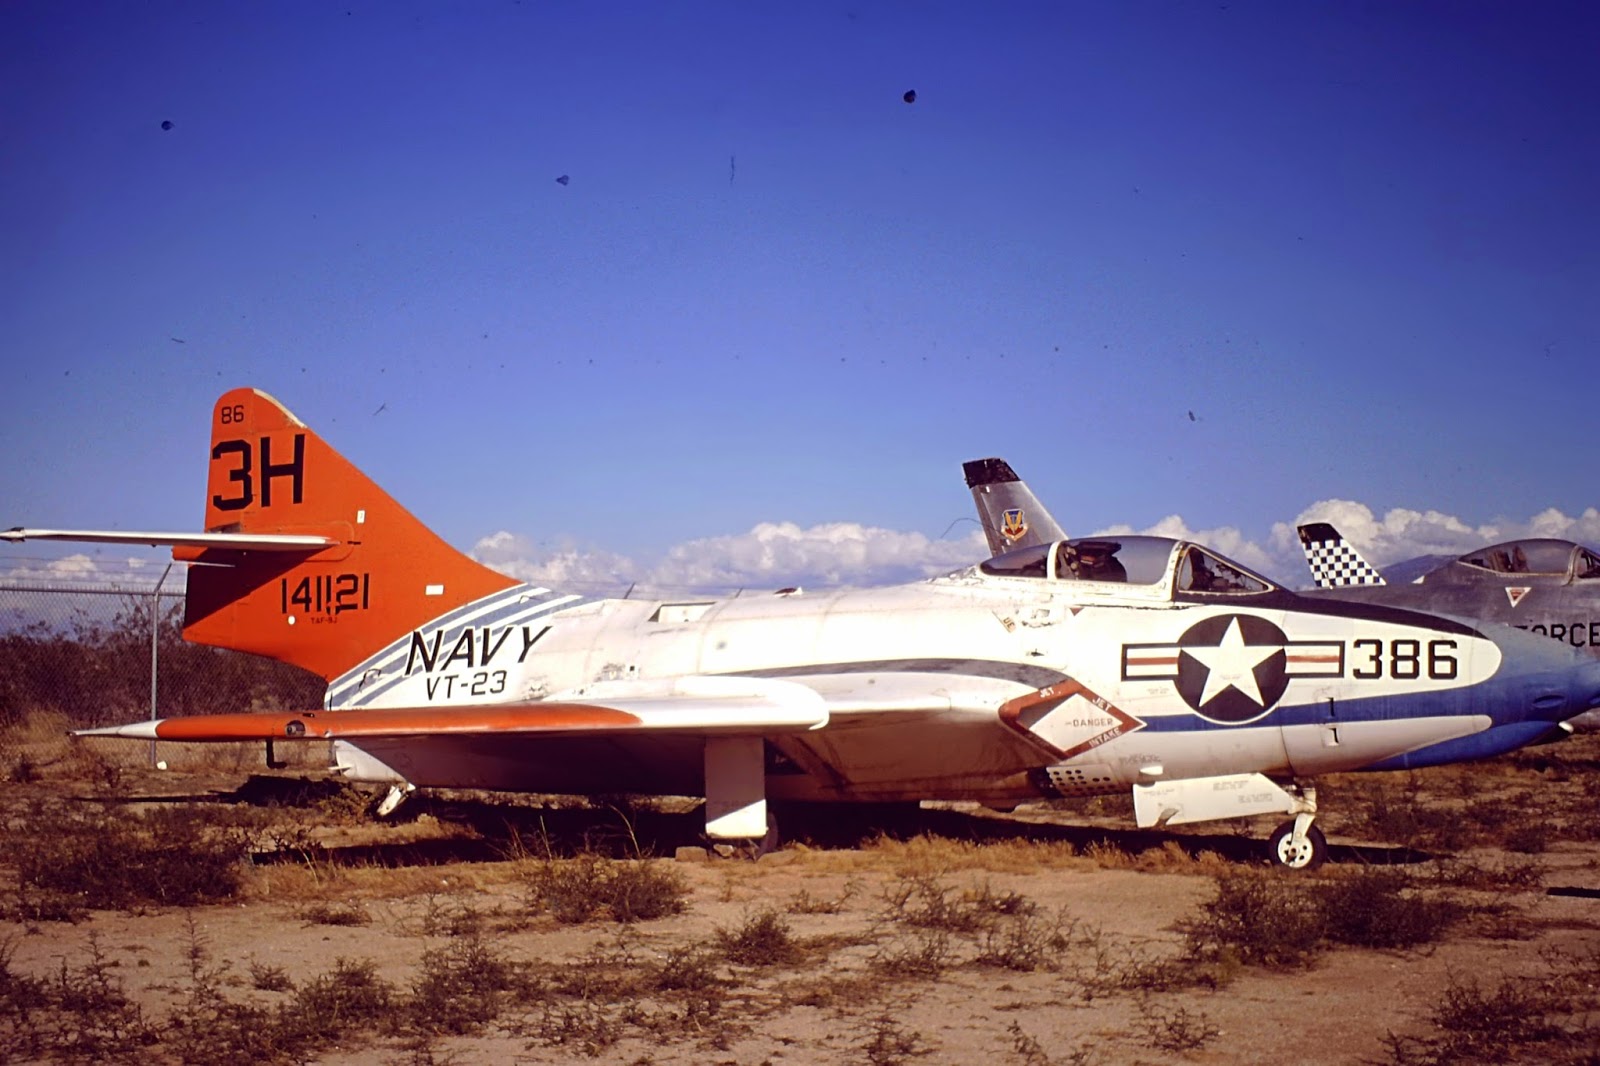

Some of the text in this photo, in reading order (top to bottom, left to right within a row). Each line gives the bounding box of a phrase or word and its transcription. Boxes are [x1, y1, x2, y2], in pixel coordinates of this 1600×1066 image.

[221, 405, 244, 424] 86
[212, 434, 305, 511] 3H
[282, 573, 369, 615] 141121
[405, 626, 553, 675] NAVY
[1353, 639, 1458, 679] 386
[426, 670, 507, 700] VT-23
[1092, 697, 1112, 711] JET
[1088, 727, 1122, 748] INTAKE
